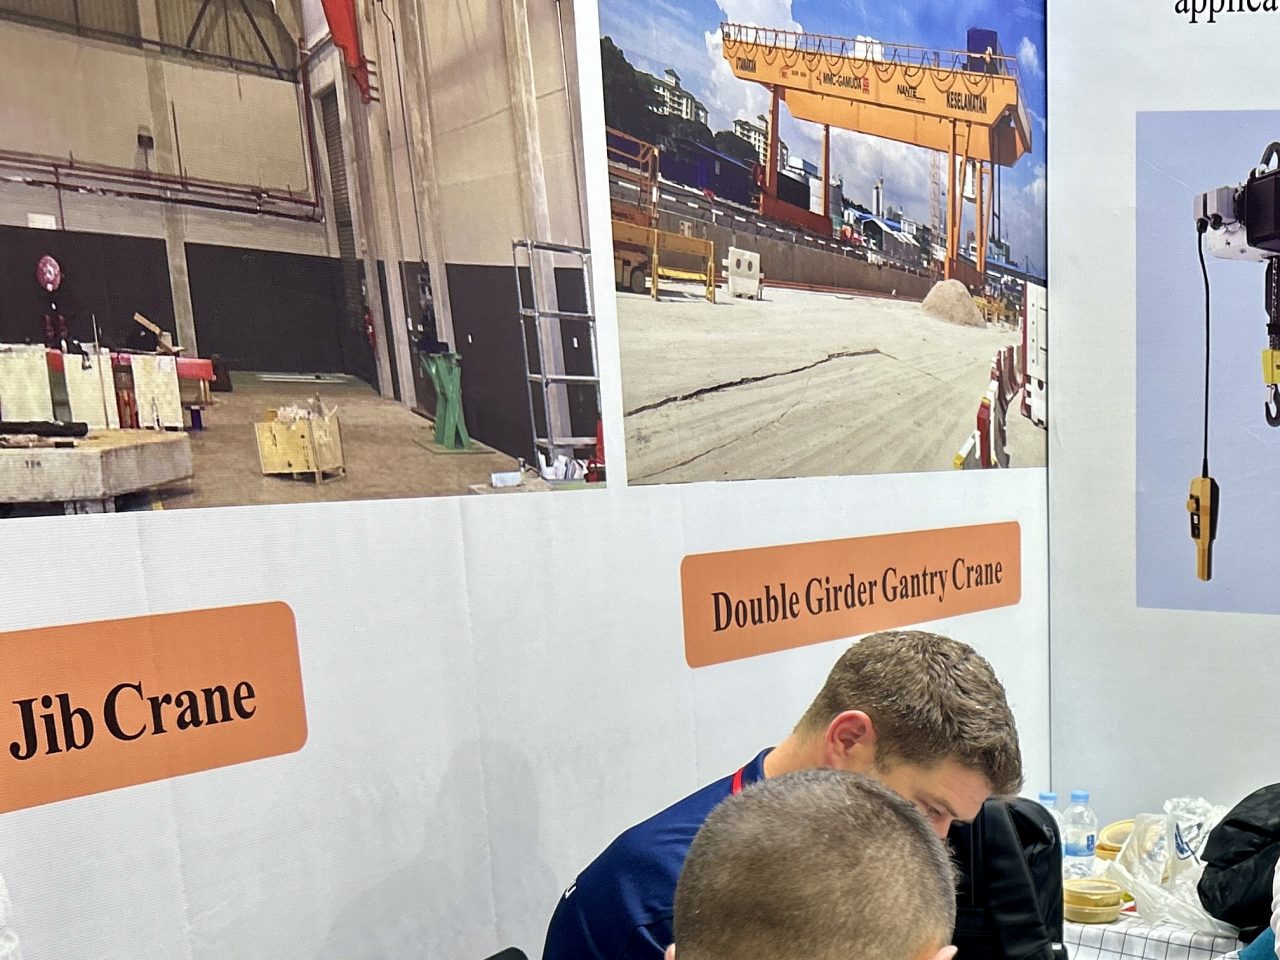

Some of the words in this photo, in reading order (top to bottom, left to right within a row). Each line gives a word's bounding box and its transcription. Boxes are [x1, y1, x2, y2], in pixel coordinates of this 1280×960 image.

[711, 583, 800, 632] Double
[805, 573, 878, 616] Girder
[882, 565, 949, 603] Gantry
[952, 557, 1003, 591] Crane
[9, 692, 95, 761] Jib
[103, 680, 257, 741] Crane
